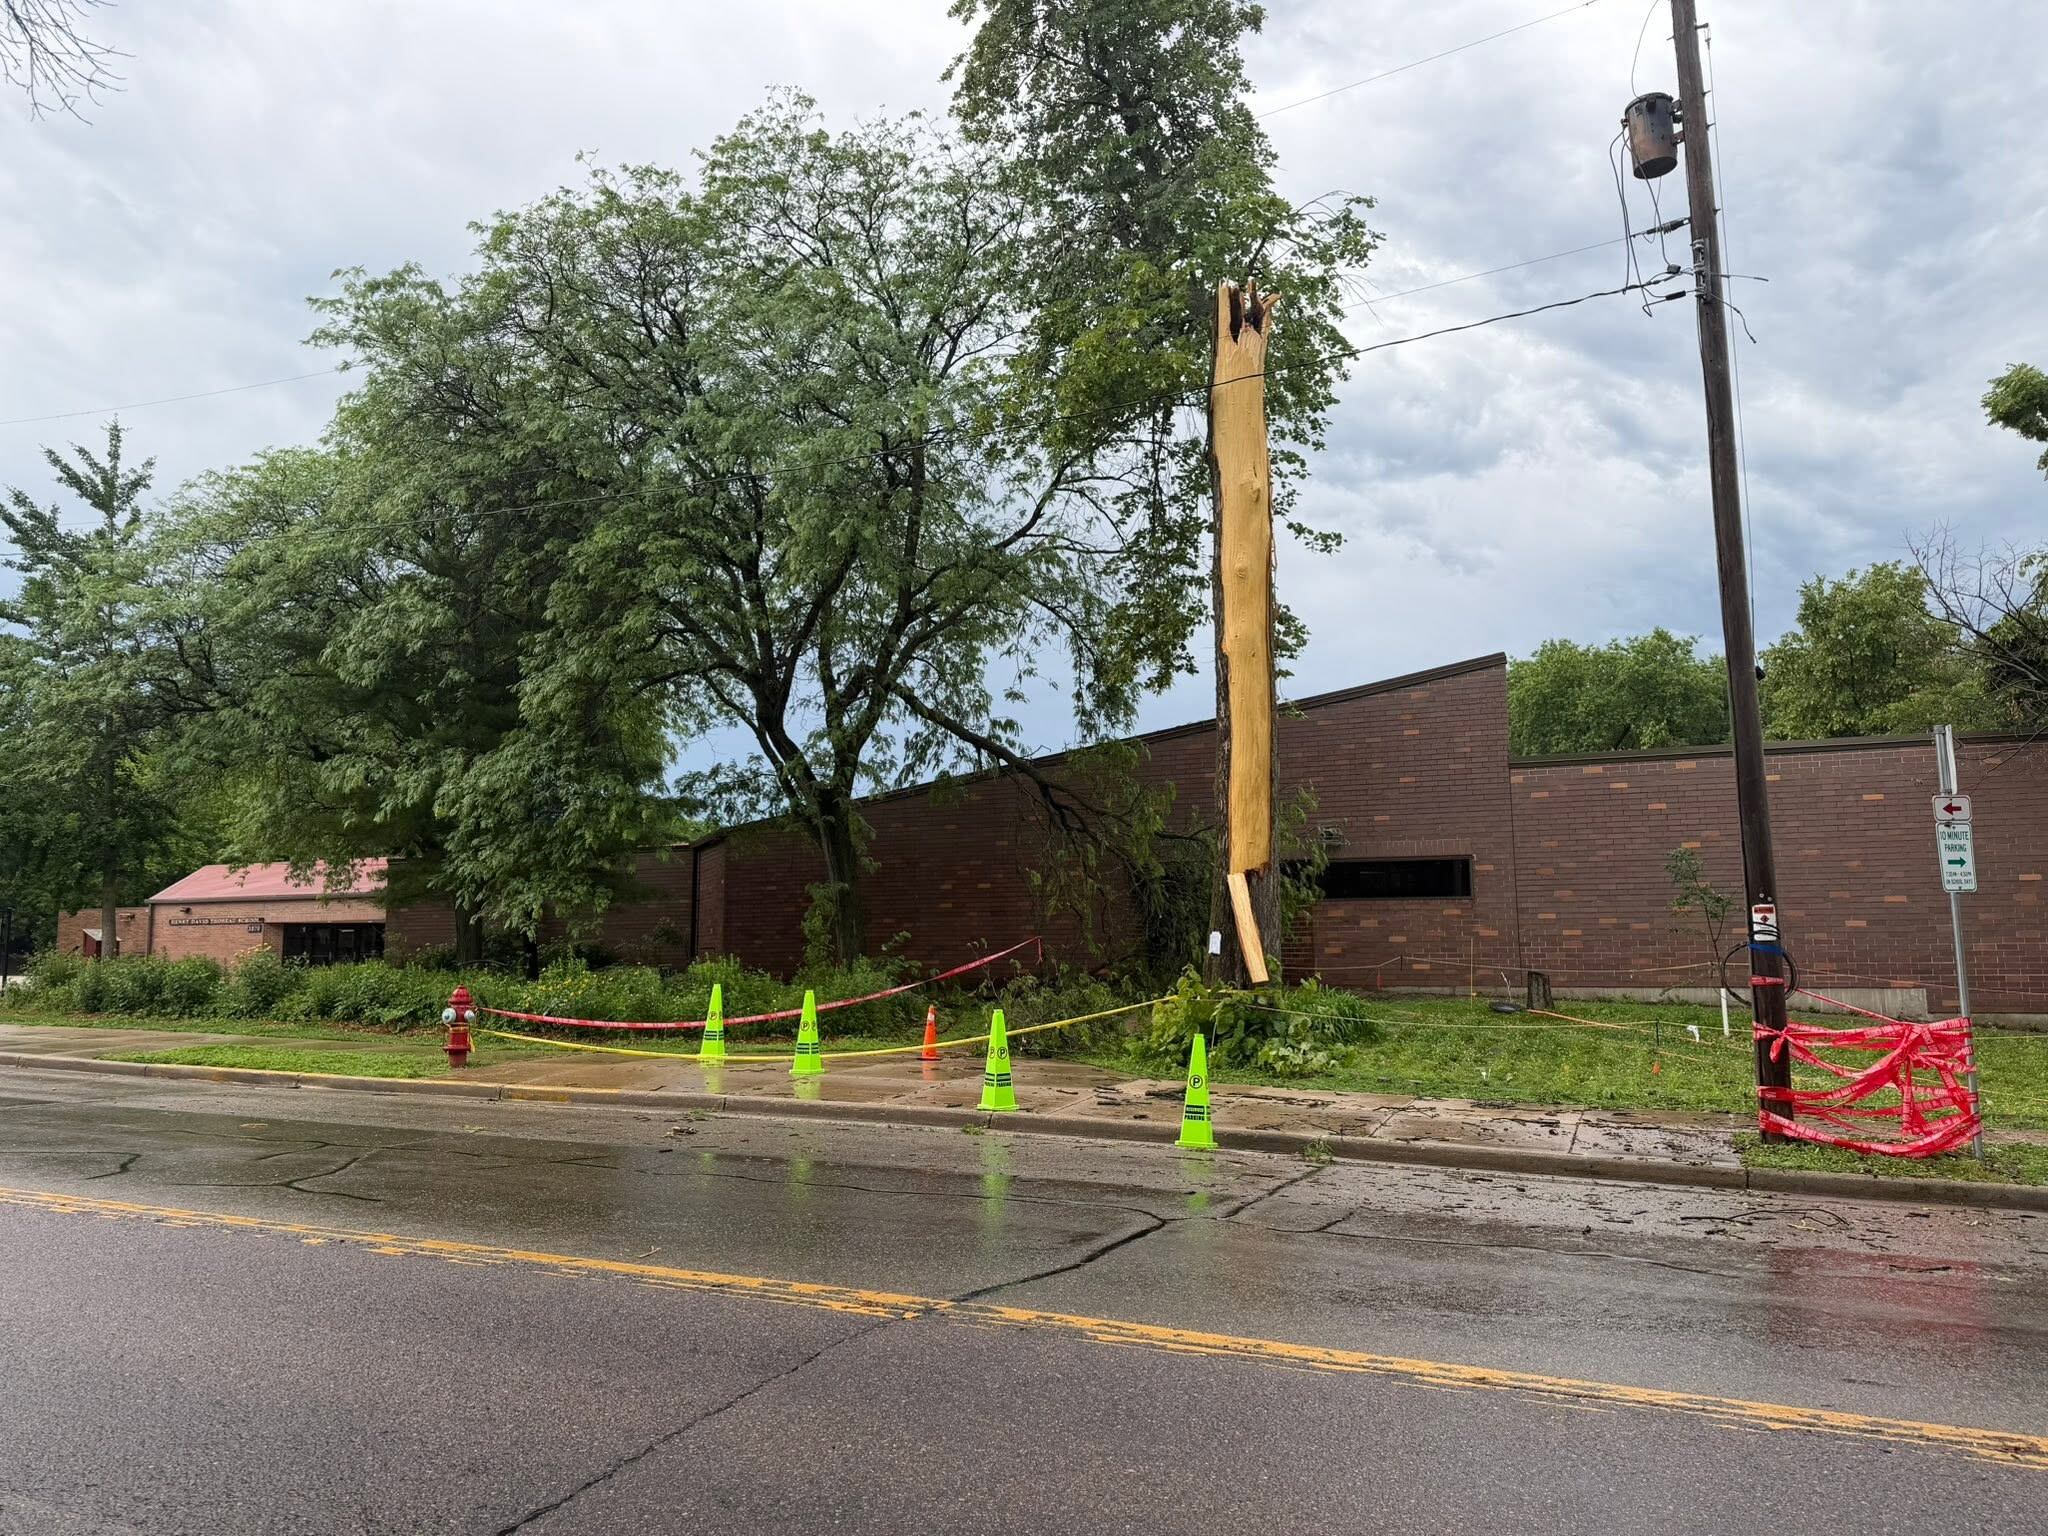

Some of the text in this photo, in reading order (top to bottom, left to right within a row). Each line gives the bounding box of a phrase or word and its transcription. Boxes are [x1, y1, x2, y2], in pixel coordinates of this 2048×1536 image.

[1940, 831, 1969, 840] 10 MINUTE
[1944, 844, 1967, 852] PARKING
